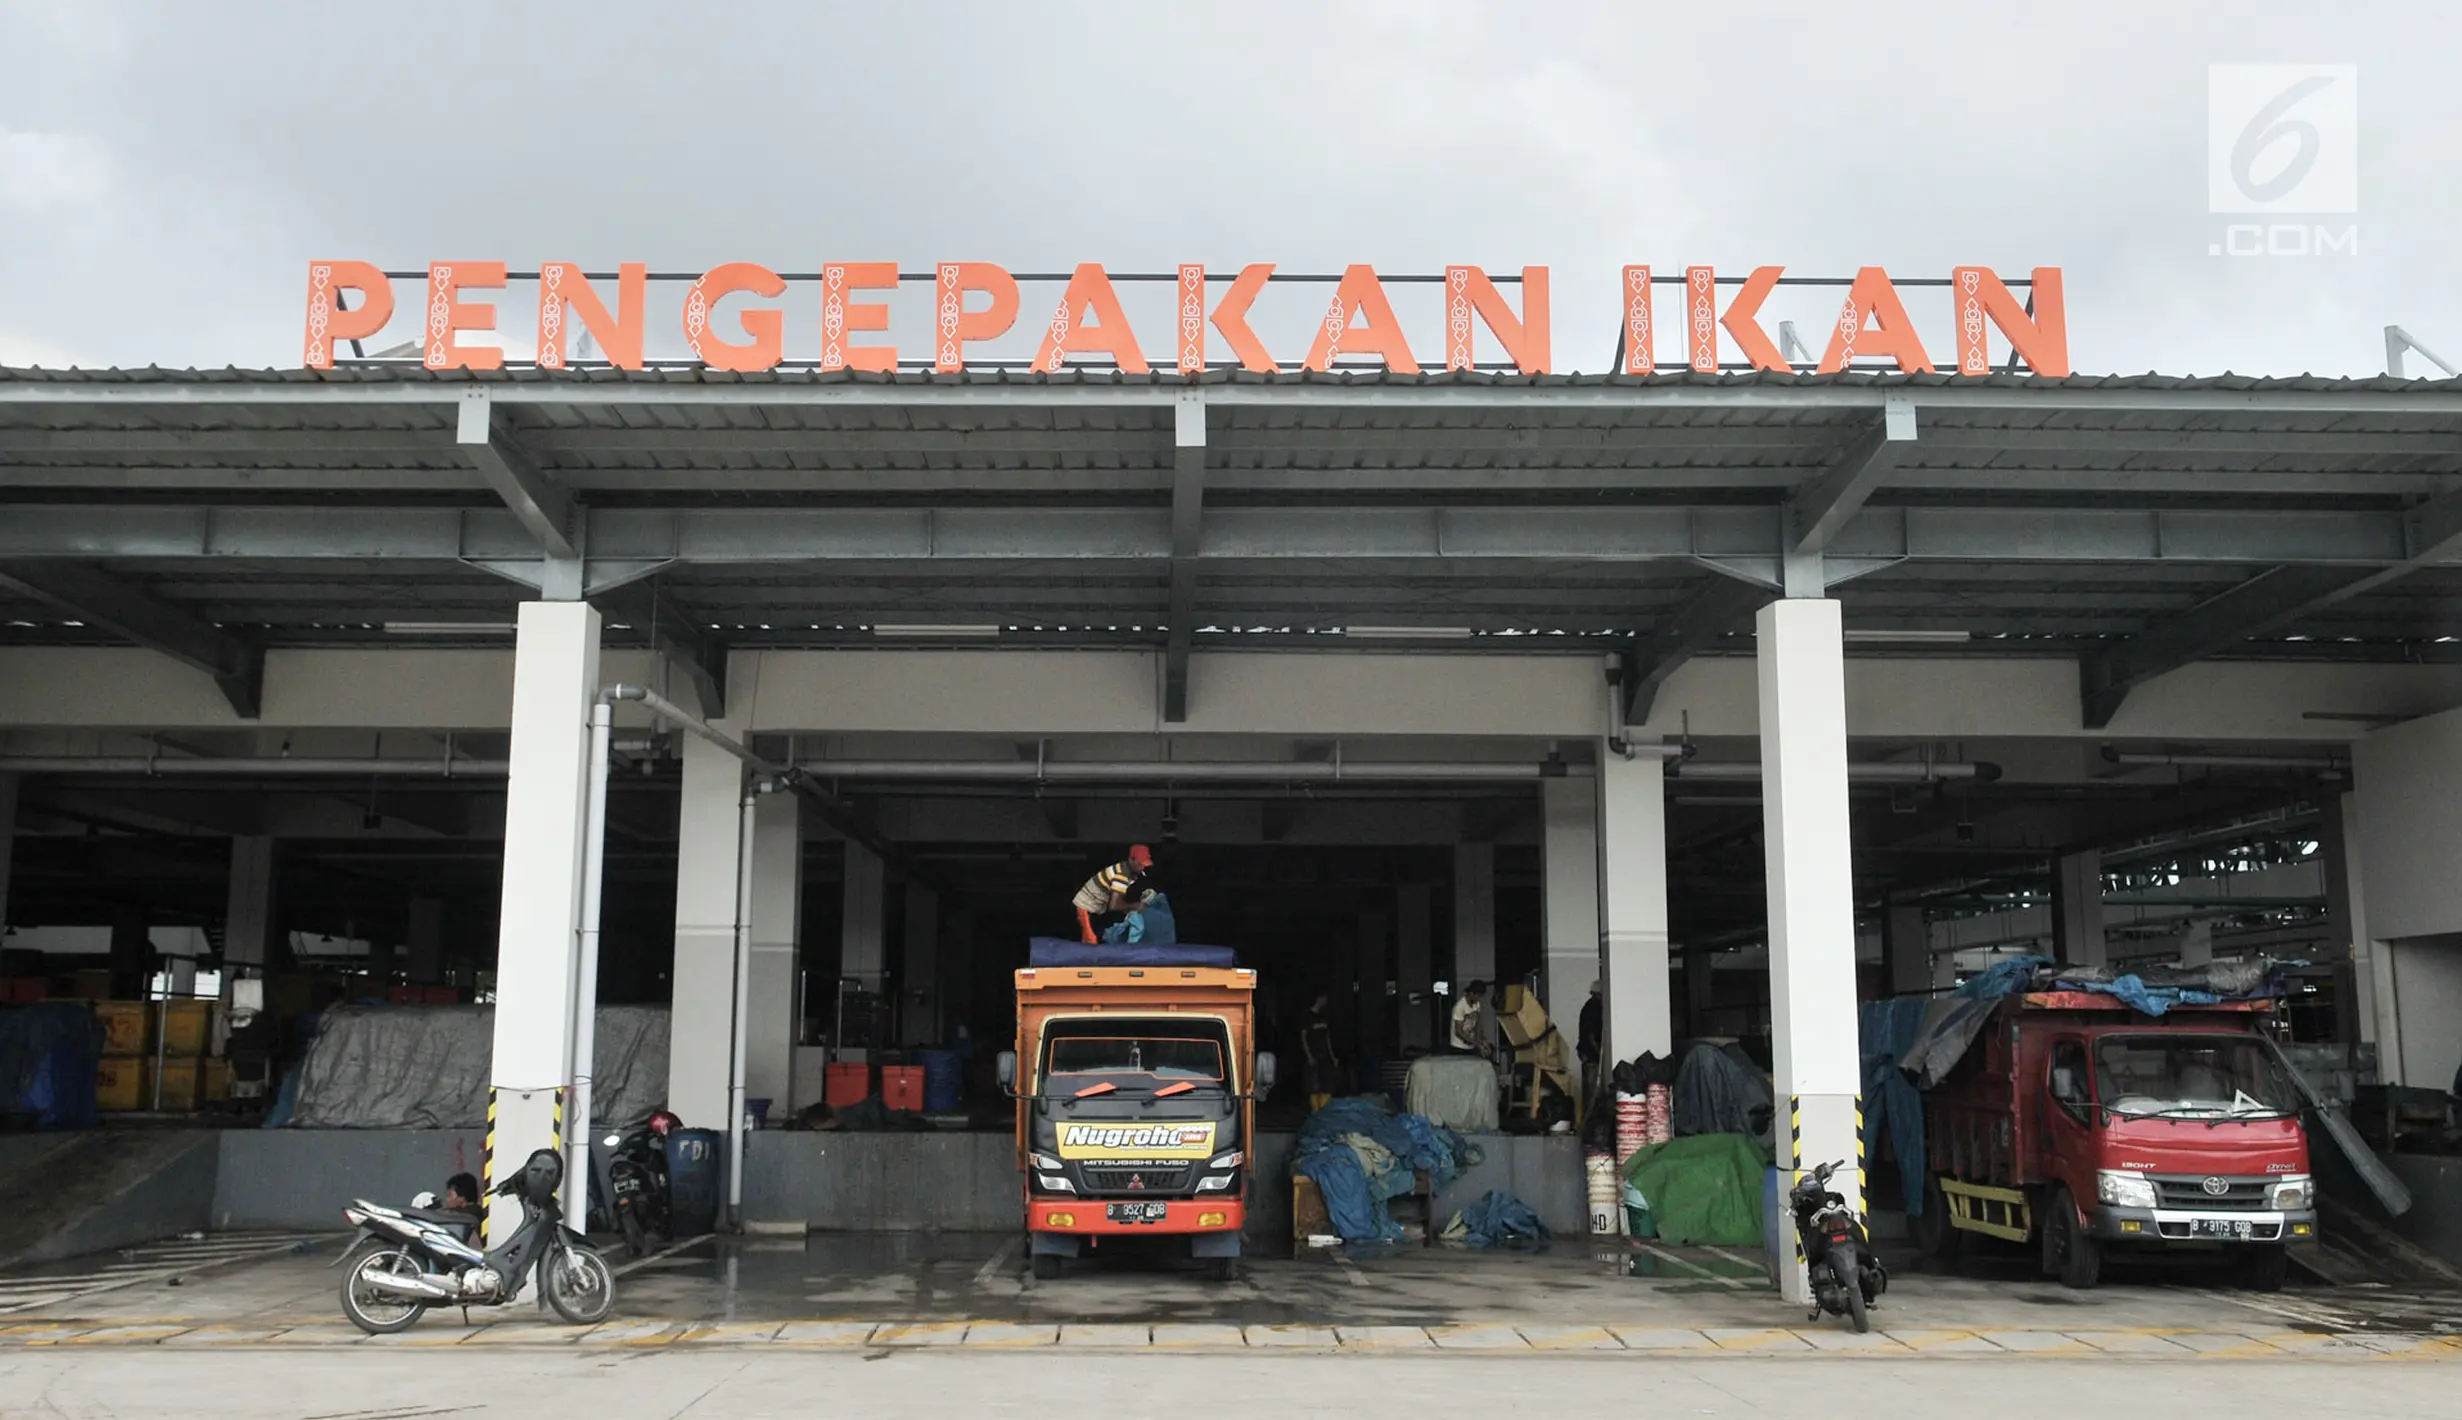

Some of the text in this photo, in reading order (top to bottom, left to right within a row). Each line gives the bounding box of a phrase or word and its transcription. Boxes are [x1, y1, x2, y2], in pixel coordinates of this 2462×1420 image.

[303, 260, 2070, 378] PENGEPAKAN IKAN
[1107, 1204, 1114, 1216] B
[1123, 1204, 1144, 1215] 9527
[2192, 1219, 2199, 1231] B
